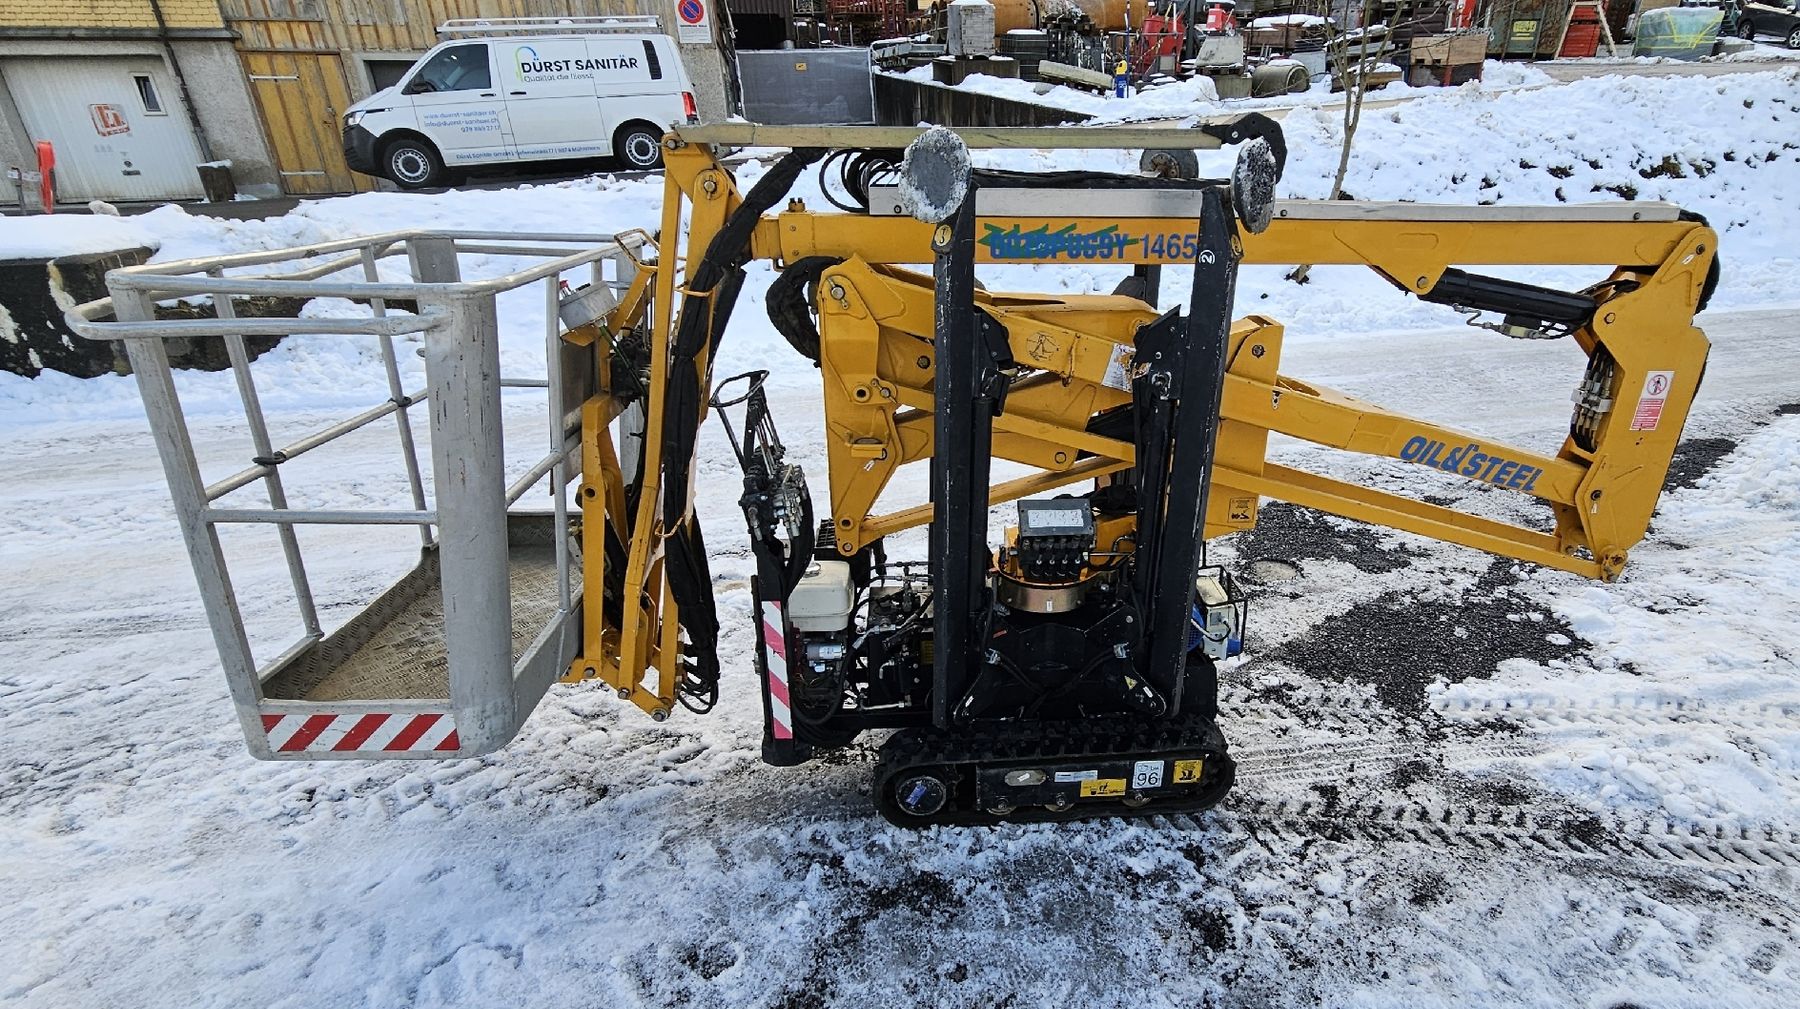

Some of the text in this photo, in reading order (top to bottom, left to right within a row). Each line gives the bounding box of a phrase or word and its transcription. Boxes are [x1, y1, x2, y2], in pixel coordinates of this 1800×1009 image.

[521, 55, 638, 73] DÜRST SANITÄR
[1139, 233, 1198, 259] 1465
[1137, 772, 1158, 786] 96
